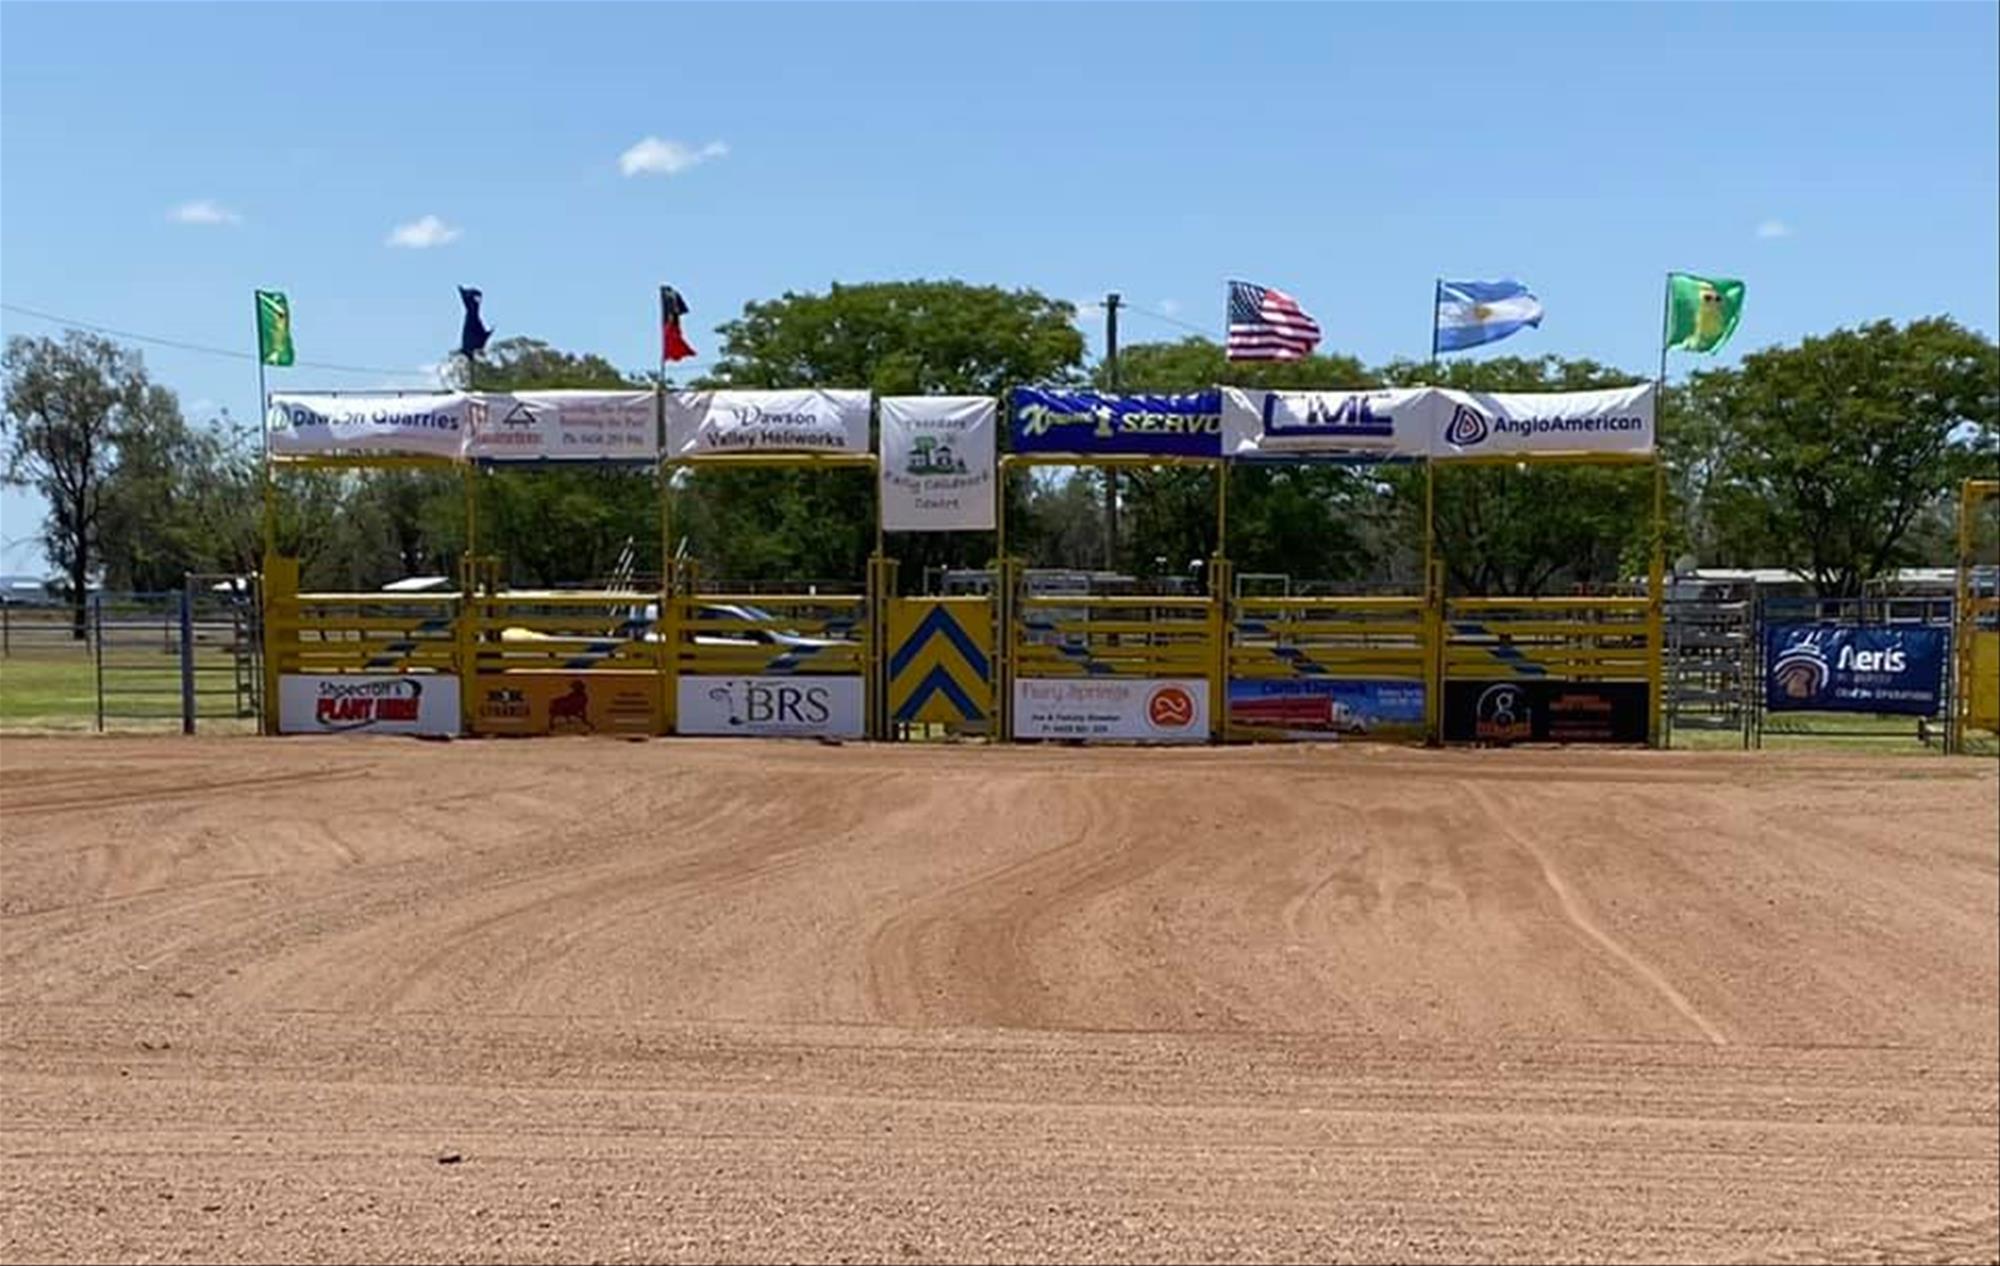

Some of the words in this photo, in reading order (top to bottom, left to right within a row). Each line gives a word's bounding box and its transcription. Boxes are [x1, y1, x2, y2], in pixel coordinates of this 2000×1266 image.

[371, 410, 460, 430] Quarries
[732, 405, 817, 427] Dawson
[1494, 414, 1642, 437] AngloAmerican
[706, 430, 756, 448] Valley
[761, 430, 846, 448] Heliworks
[1837, 645, 1907, 672] Aeris
[317, 698, 374, 721] PLANT
[747, 688, 830, 724] BRS
